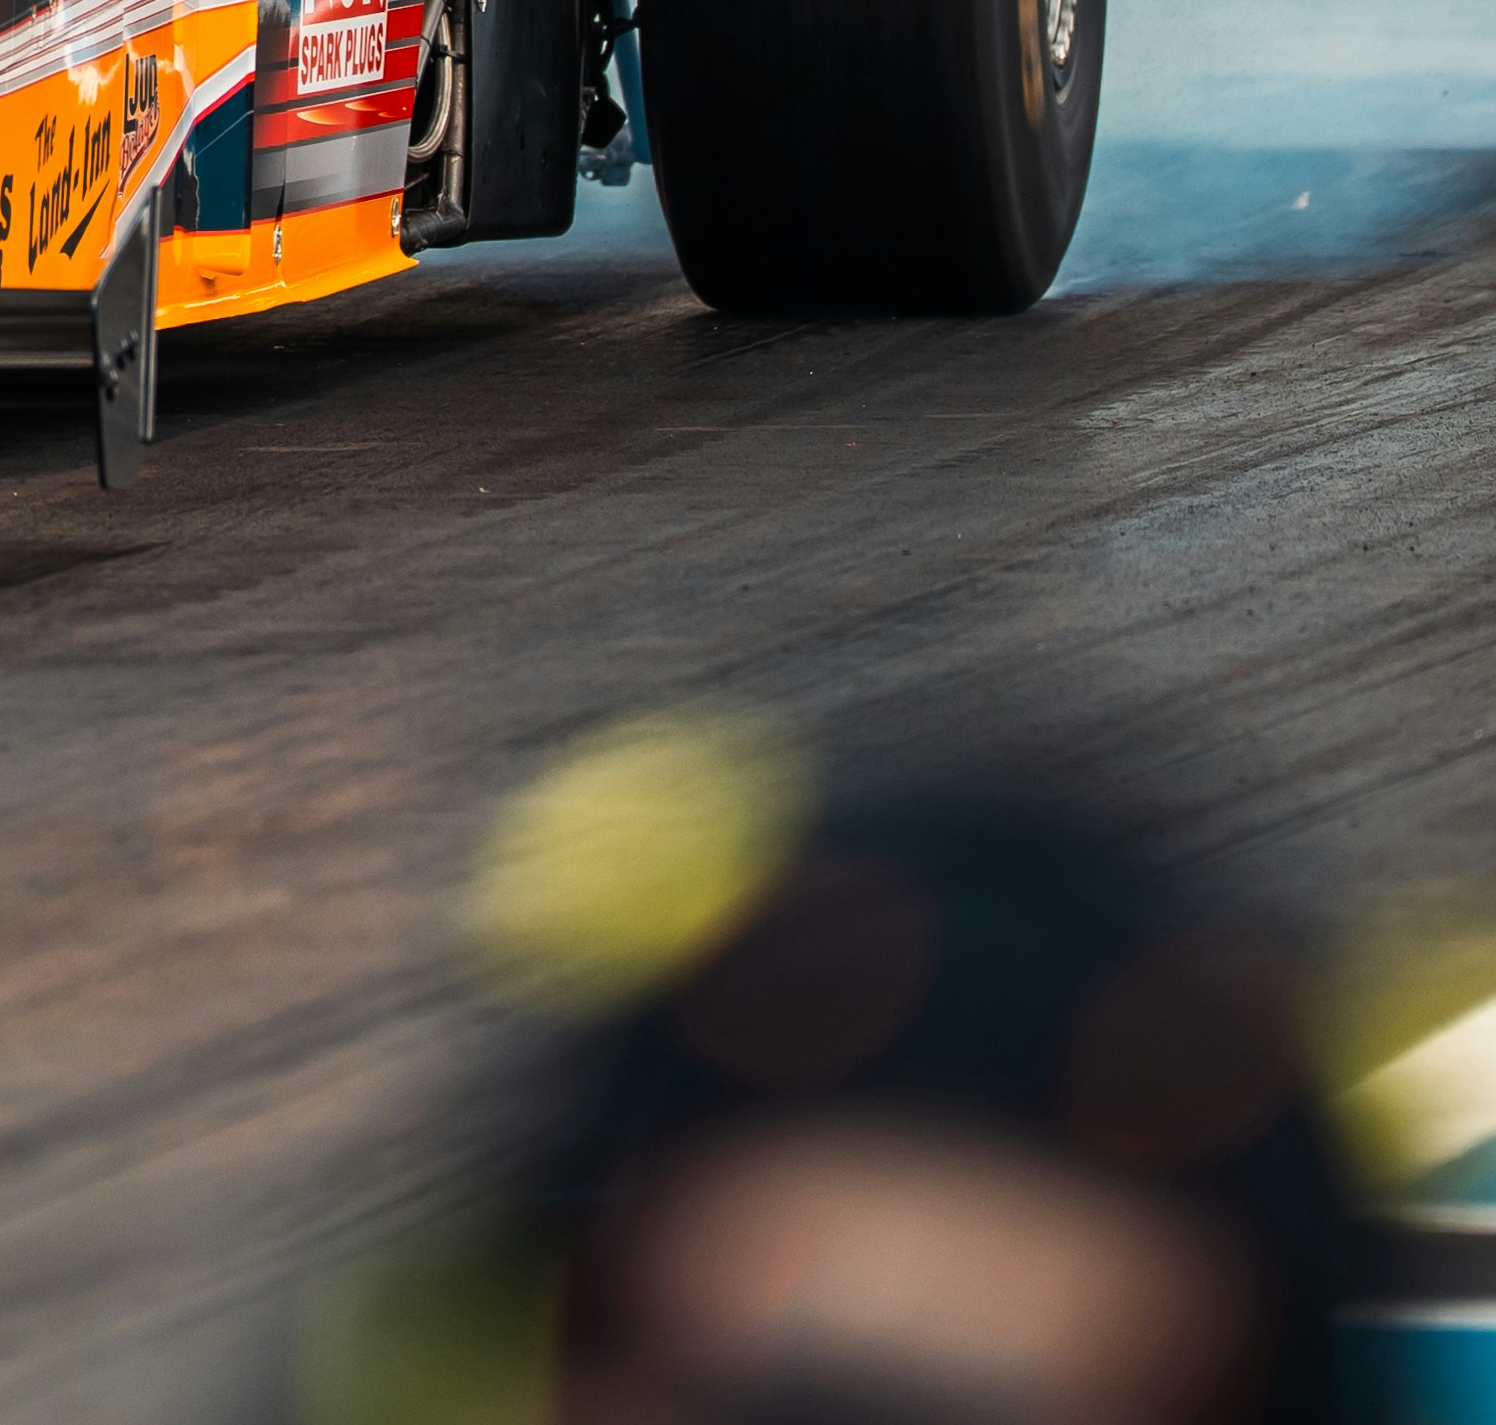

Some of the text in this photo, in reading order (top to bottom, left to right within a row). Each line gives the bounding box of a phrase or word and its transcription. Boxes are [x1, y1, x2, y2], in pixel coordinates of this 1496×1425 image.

[300, 22, 384, 86] SPARK PLUGS
[34, 113, 57, 173] The
[28, 109, 111, 275] Land-Inn
